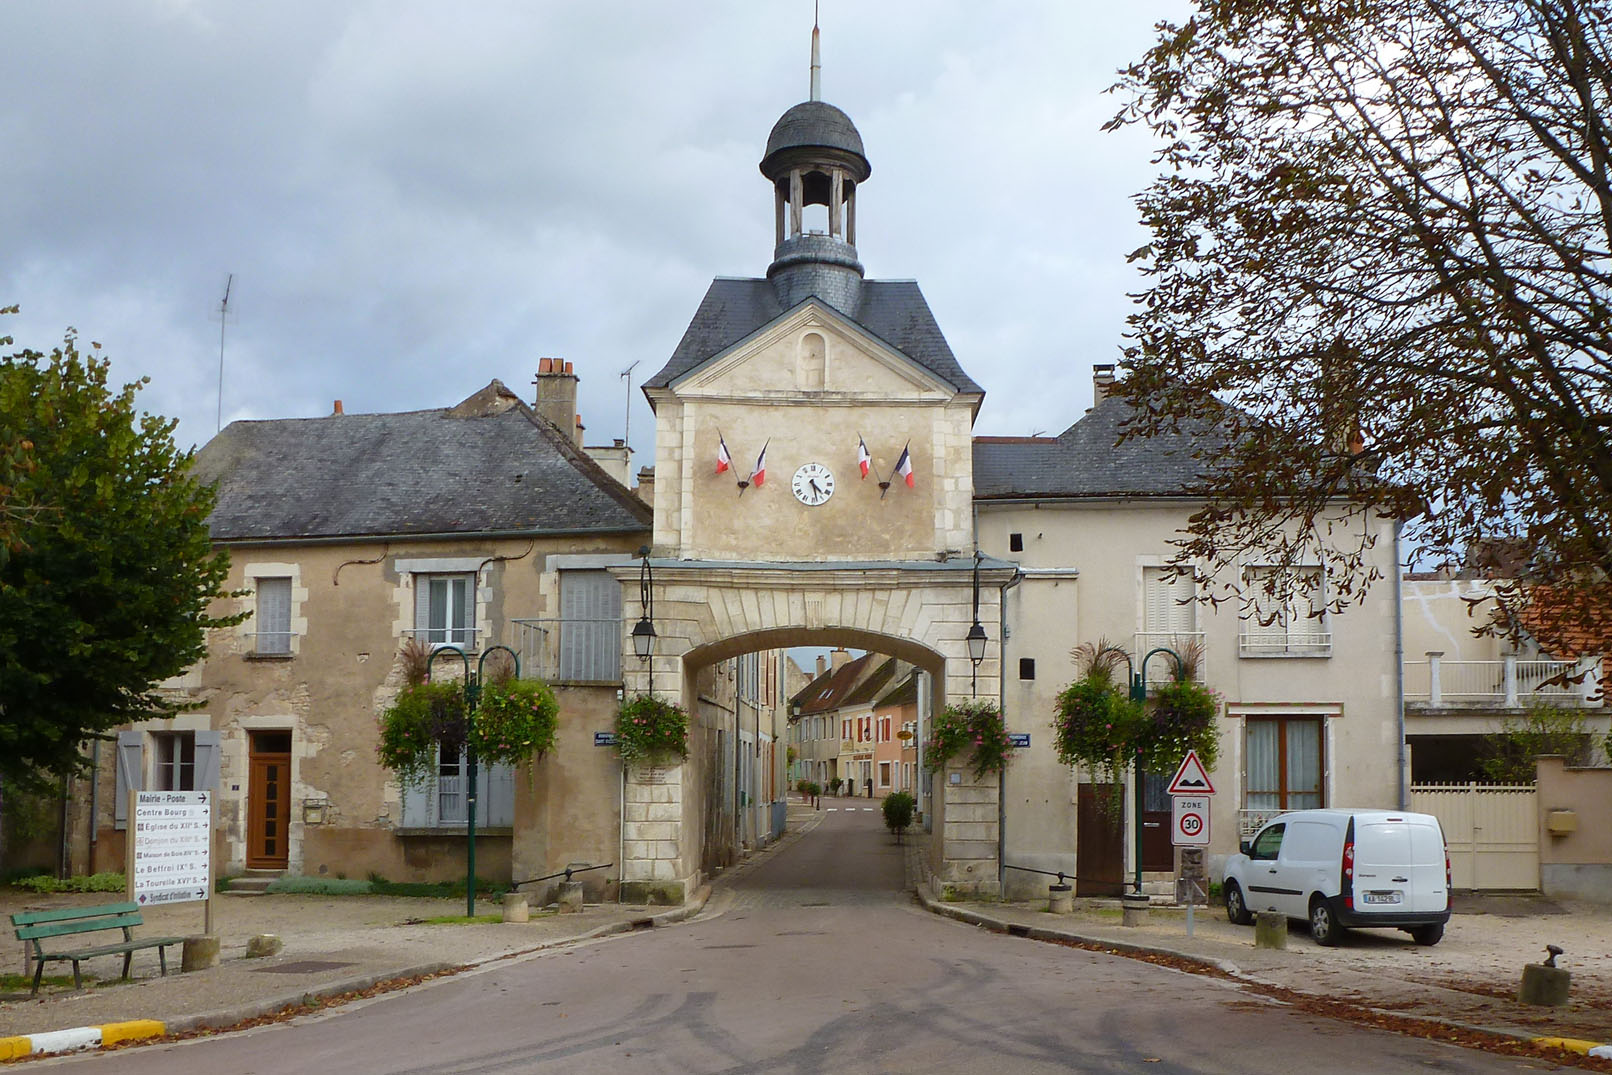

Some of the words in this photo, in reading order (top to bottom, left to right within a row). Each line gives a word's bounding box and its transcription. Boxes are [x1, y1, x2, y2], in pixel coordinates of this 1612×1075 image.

[139, 794, 161, 803] Mairie
[166, 794, 186, 803] Poste
[164, 808, 187, 816] Bourg
[1184, 819, 1199, 829] 30
[147, 865, 174, 873] Beffroi
[146, 879, 175, 887] Tourelle
[150, 893, 169, 903] Syndicat
